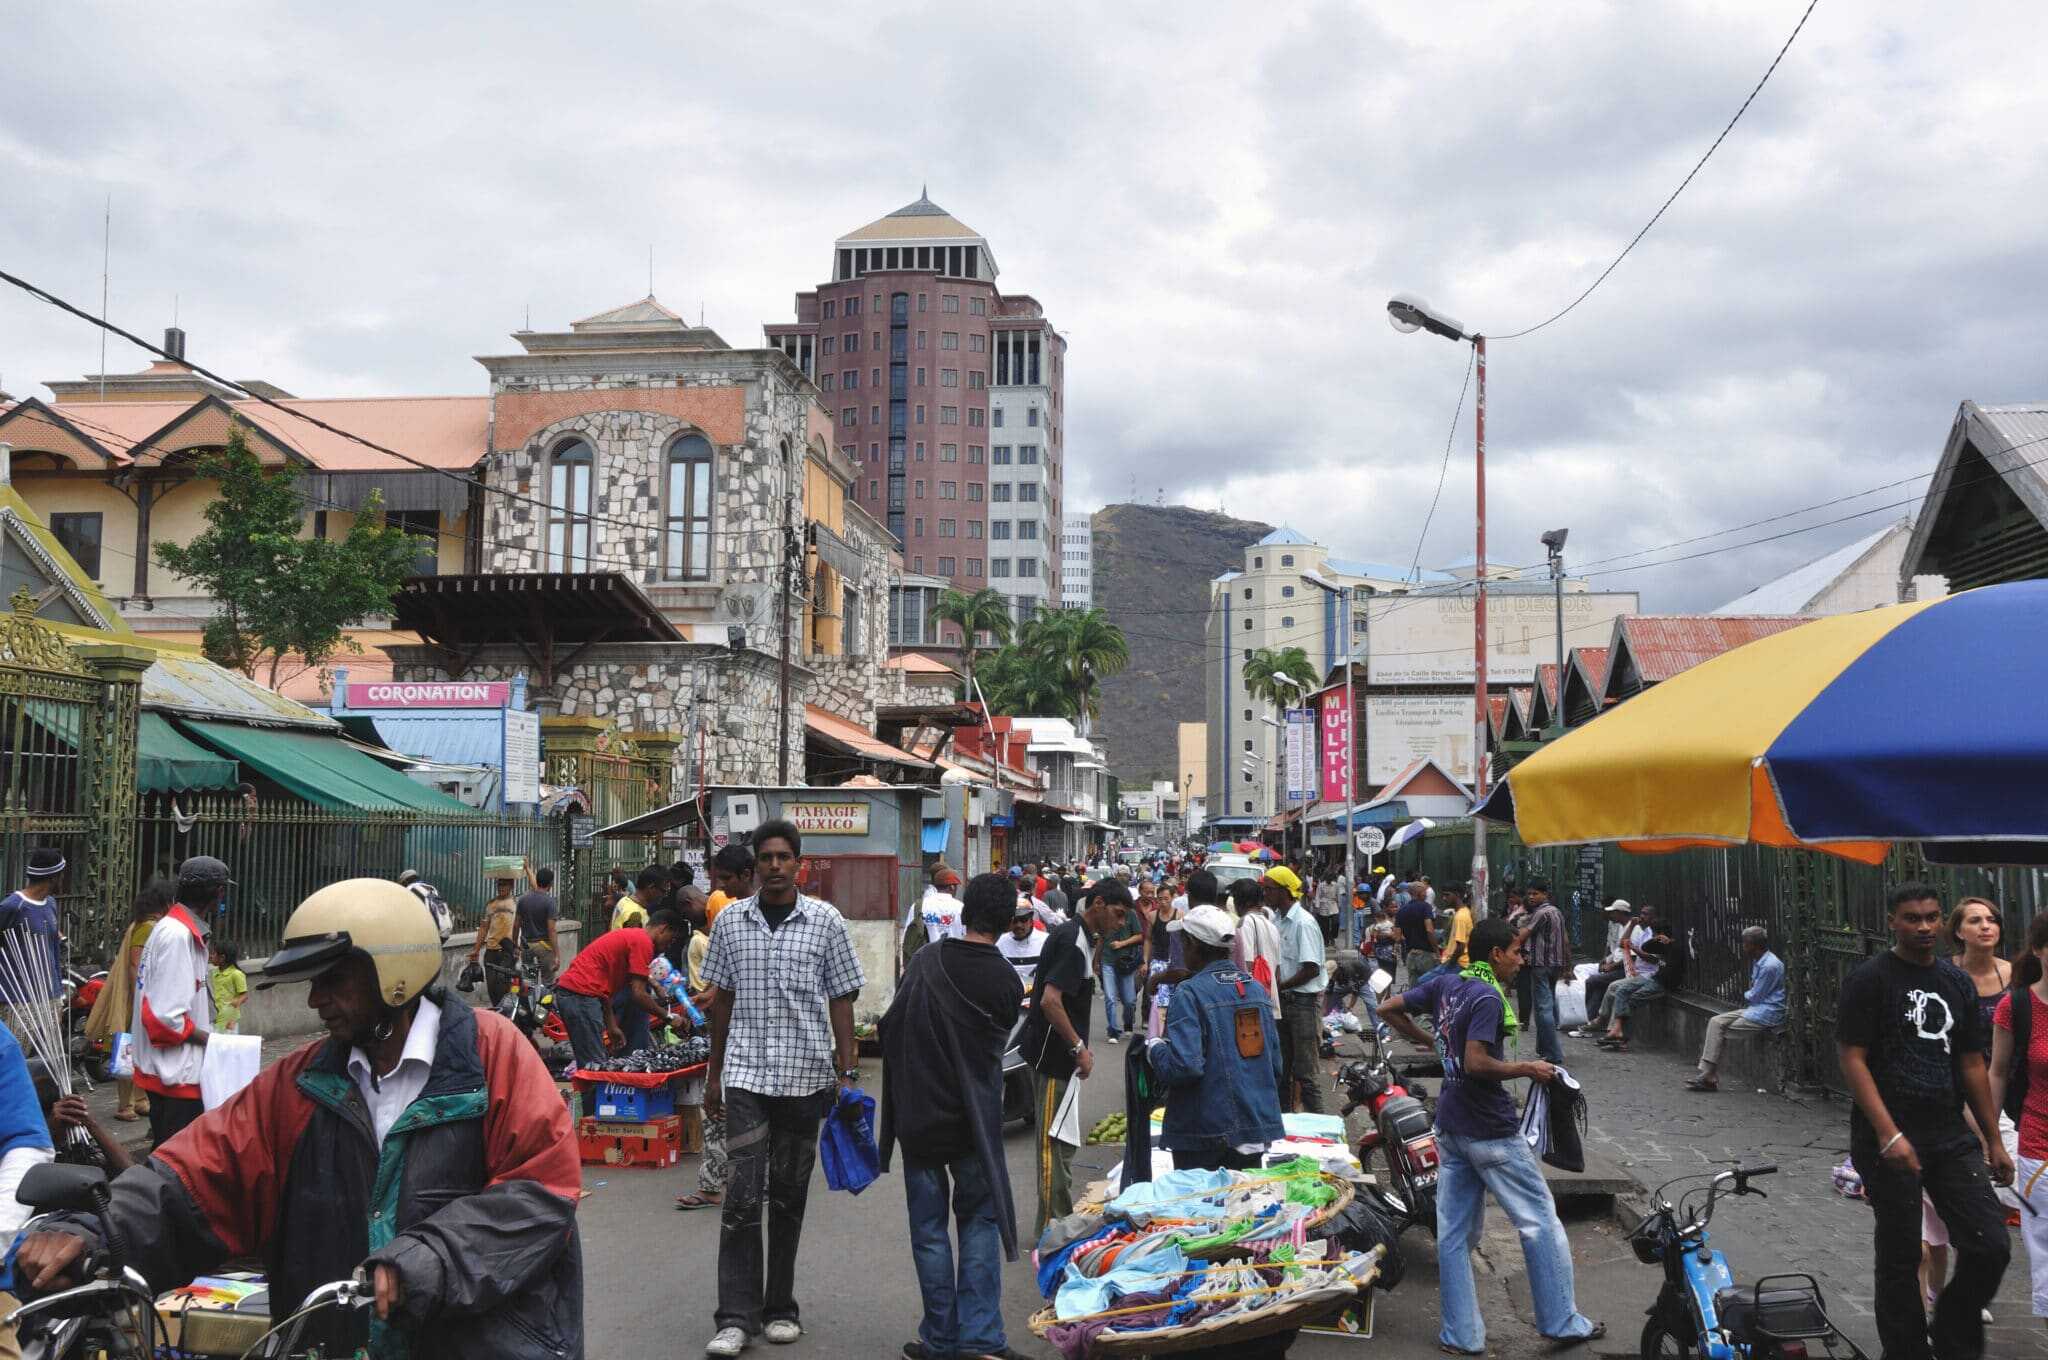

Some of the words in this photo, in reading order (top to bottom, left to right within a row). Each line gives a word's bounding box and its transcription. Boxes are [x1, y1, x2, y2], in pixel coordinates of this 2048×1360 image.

[1438, 596, 1507, 612] MUTI
[1514, 596, 1592, 612] DECOR
[367, 682, 490, 705] CORONATION
[1325, 695, 1341, 784] MULTI
[792, 805, 858, 817] TABAGIE
[795, 818, 854, 830] MEXICO
[1359, 831, 1383, 840] CROSS
[1360, 840, 1380, 848] HERE
